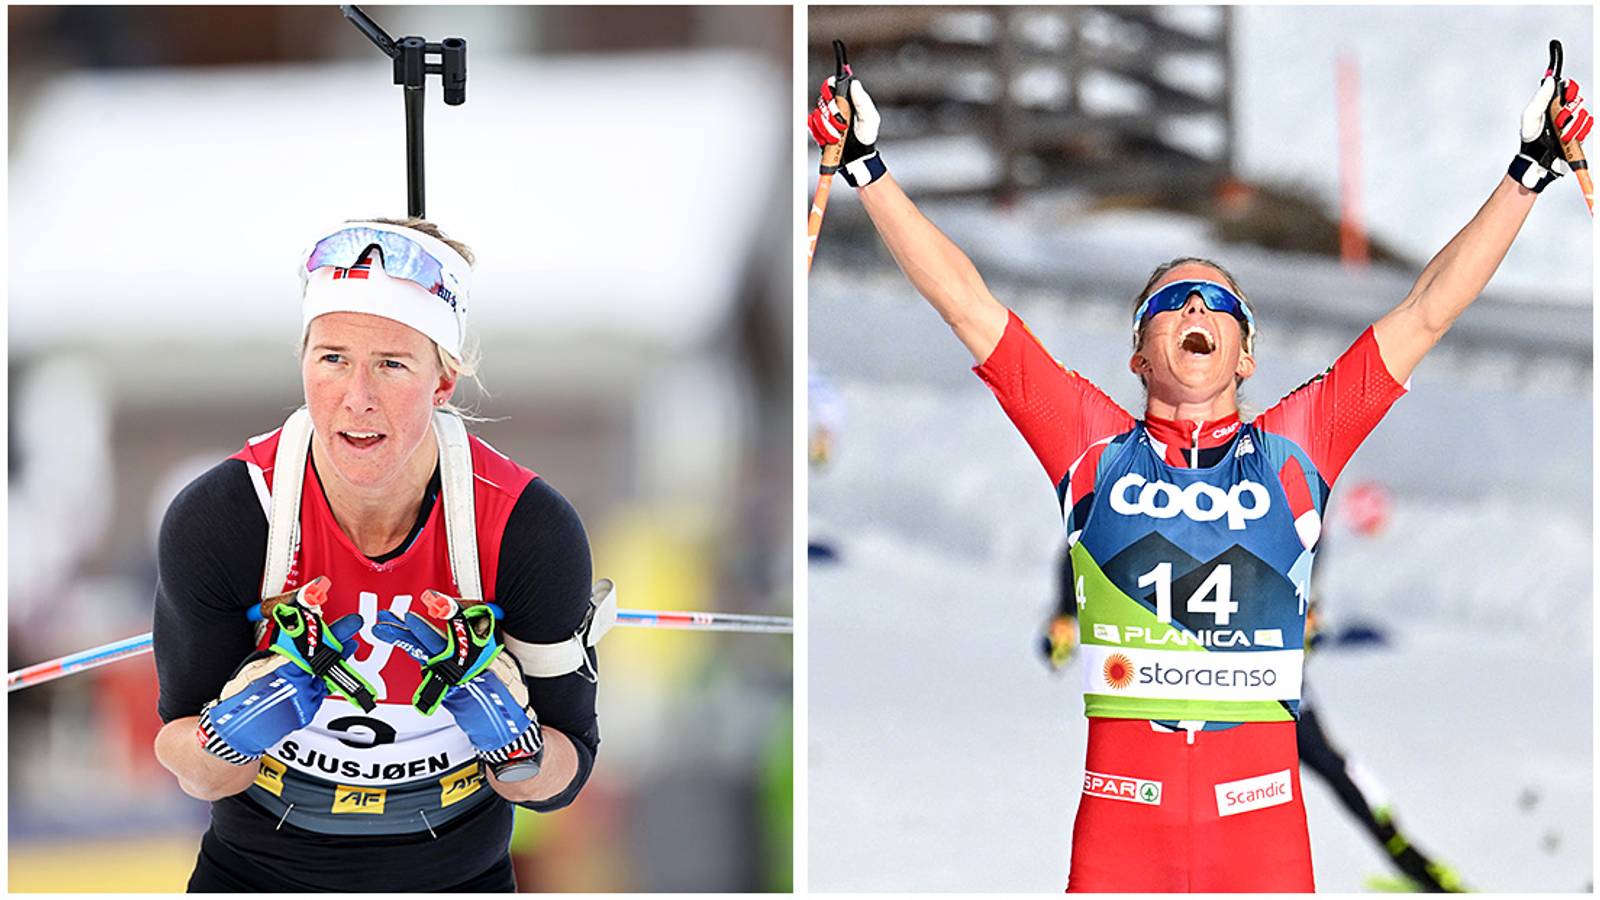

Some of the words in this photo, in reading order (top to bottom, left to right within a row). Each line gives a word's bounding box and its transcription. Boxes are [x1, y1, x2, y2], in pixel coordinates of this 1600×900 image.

[1109, 472, 1271, 530] coop
[1137, 562, 1239, 626] 14
[1124, 625, 1251, 648] PLANICA
[278, 740, 449, 780] SJUSJØEN
[339, 790, 381, 807] AF
[1084, 775, 1136, 798] SPAR
[1225, 781, 1286, 807] Scandic
